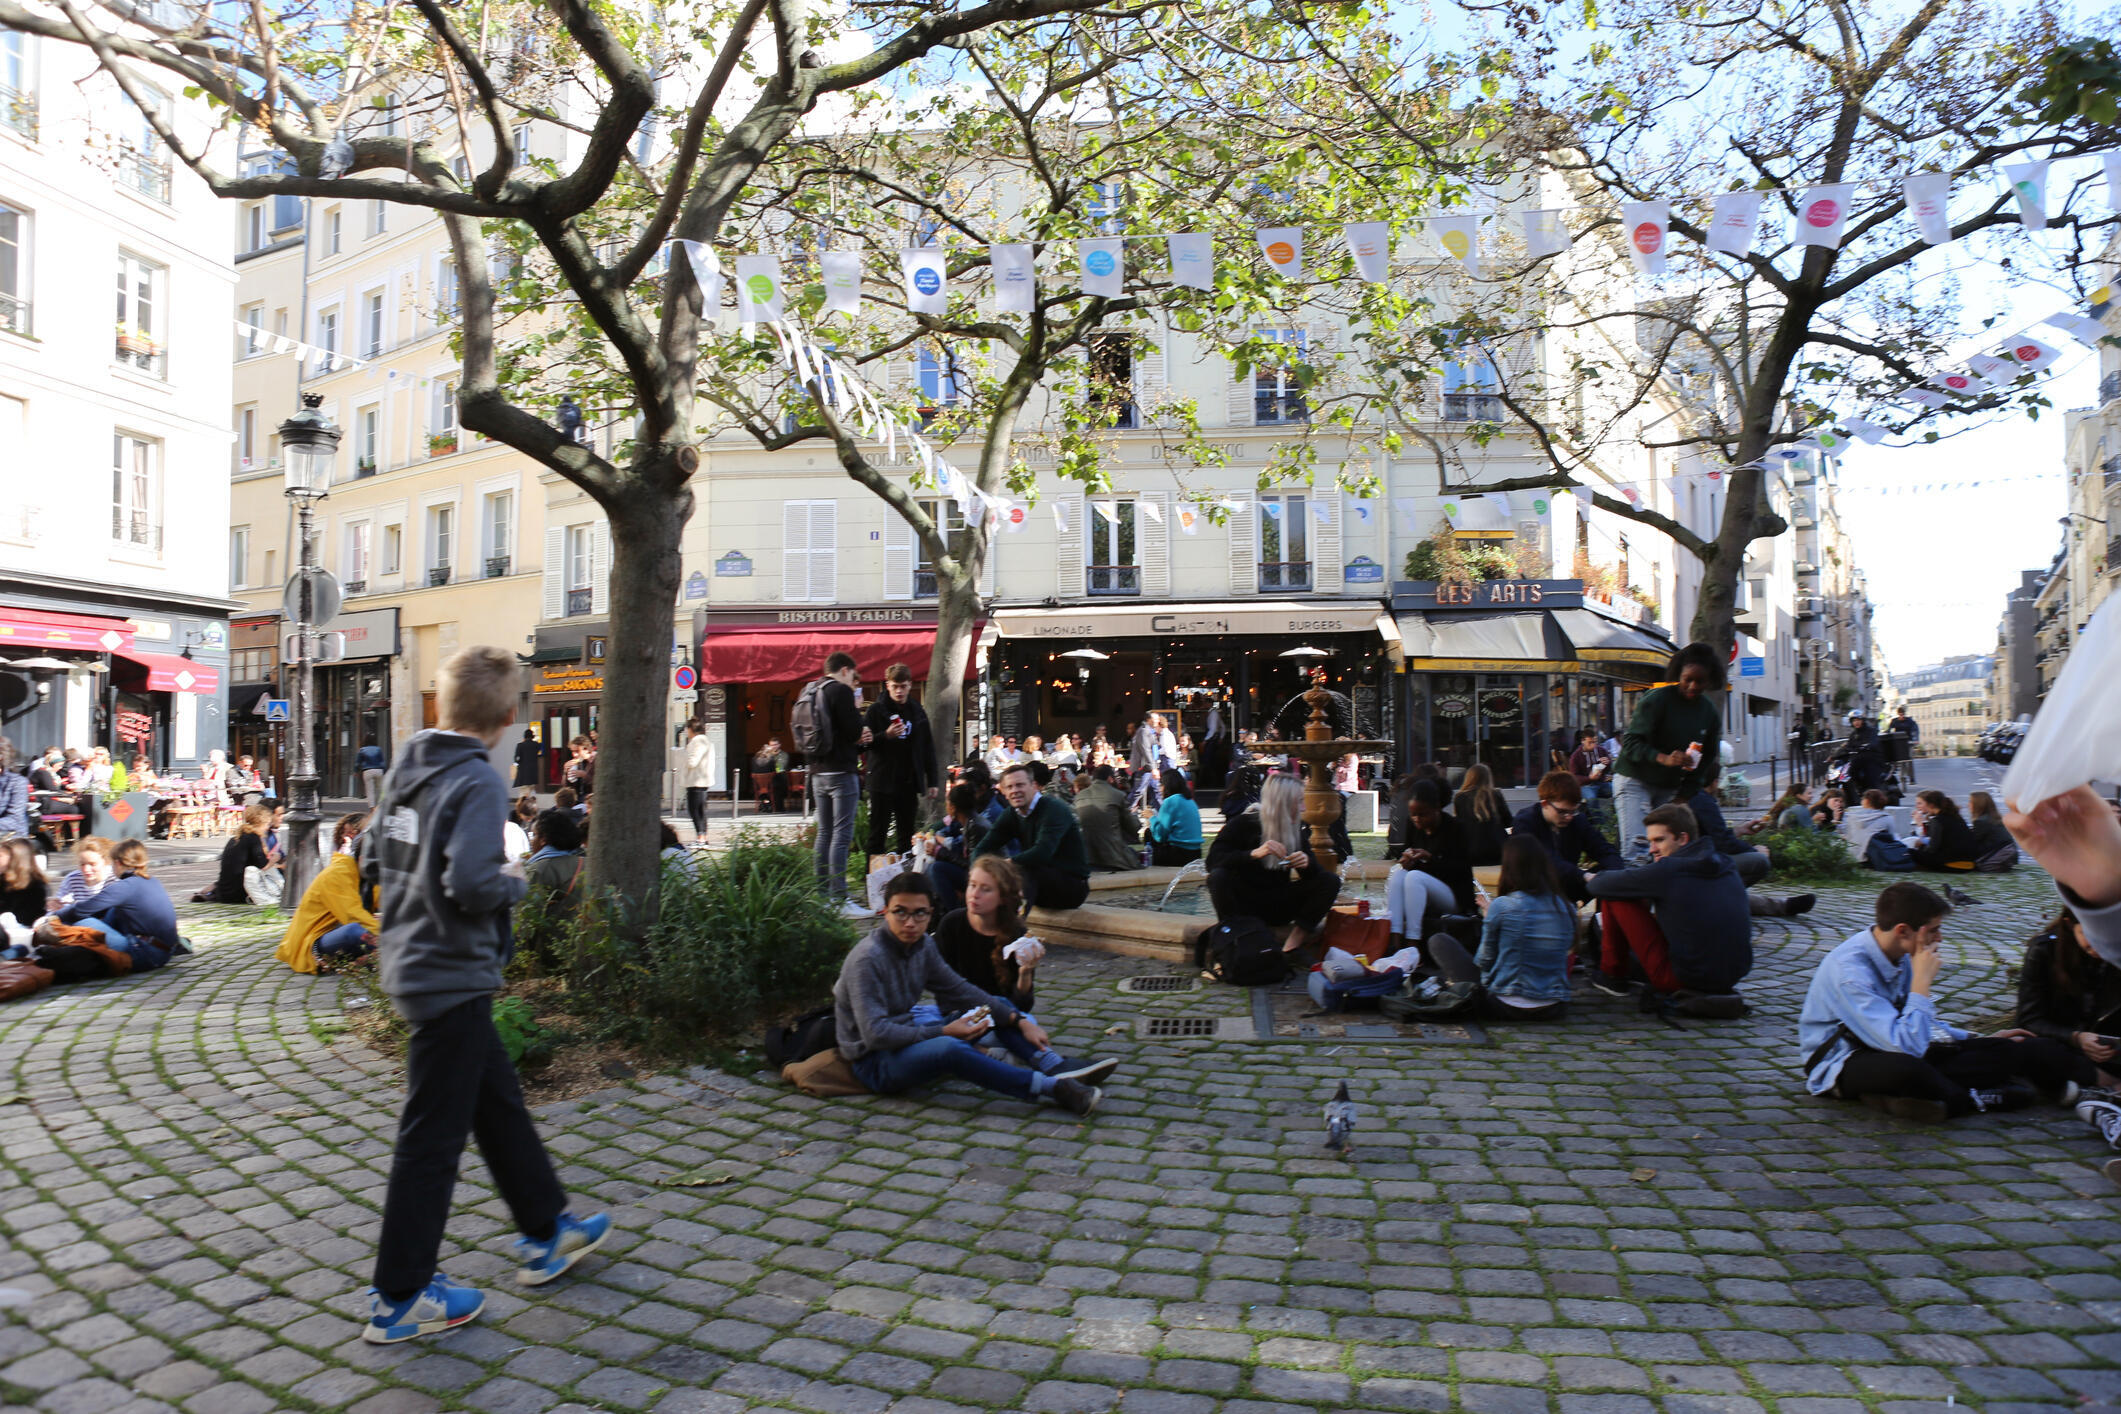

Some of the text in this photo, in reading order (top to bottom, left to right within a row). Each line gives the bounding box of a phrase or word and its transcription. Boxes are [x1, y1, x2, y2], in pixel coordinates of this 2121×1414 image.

[1436, 583, 1542, 604] LES ARTS
[778, 610, 913, 623] BISTRO ITALIEN
[1033, 626, 1093, 636] LIMONADE
[1152, 616, 1229, 633] GASTON
[1289, 621, 1342, 631] BURGERS
